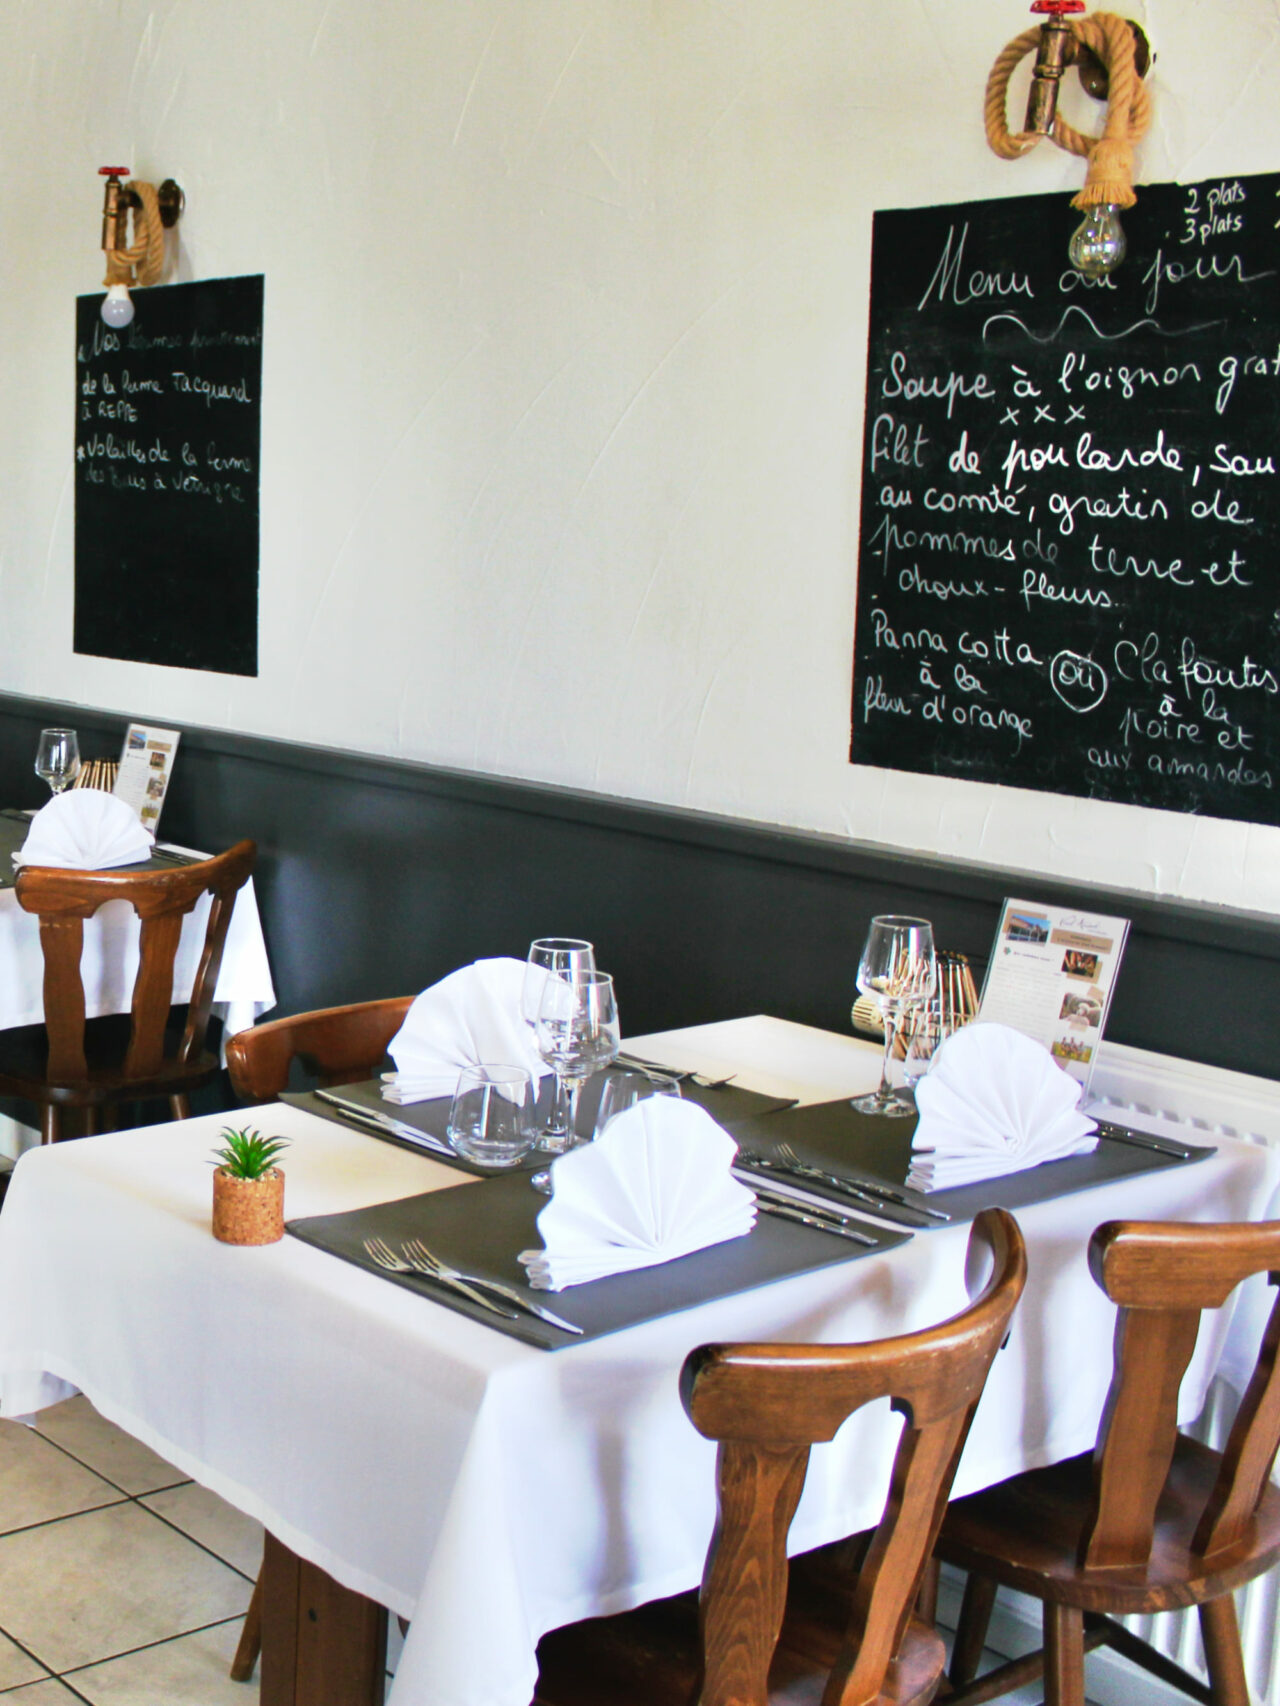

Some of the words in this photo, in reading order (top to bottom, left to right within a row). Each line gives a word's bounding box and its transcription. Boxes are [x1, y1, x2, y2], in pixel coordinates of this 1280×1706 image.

[1183, 188, 1200, 214] 2
[1206, 181, 1245, 222] plats
[1180, 218, 1196, 243] 3
[1199, 213, 1242, 245] plats
[918, 222, 1035, 311] Menu
[1142, 240, 1276, 314] jour
[82, 371, 96, 395] de
[103, 373, 116, 394] la
[882, 352, 996, 418] Soupe
[1011, 365, 1041, 397] à
[1059, 352, 1201, 398] l'oignon
[149, 438, 169, 462] de
[182, 442, 198, 466] la
[949, 430, 982, 475] de
[880, 485, 913, 508] au
[1049, 486, 1168, 535] gratin
[1191, 489, 1254, 524] de
[868, 513, 1016, 576] pommes
[1023, 528, 1058, 565] de
[1089, 534, 1194, 585] terre
[1201, 550, 1253, 586] et
[871, 609, 948, 653] Panna
[959, 627, 1043, 666] cotta
[920, 661, 941, 689] à
[954, 663, 988, 694] la
[1158, 694, 1183, 717] à
[1202, 687, 1235, 726] la
[1119, 707, 1204, 747] poire
[1218, 725, 1254, 750] et
[1088, 748, 1132, 770] aux
[1148, 756, 1272, 789] amandes
